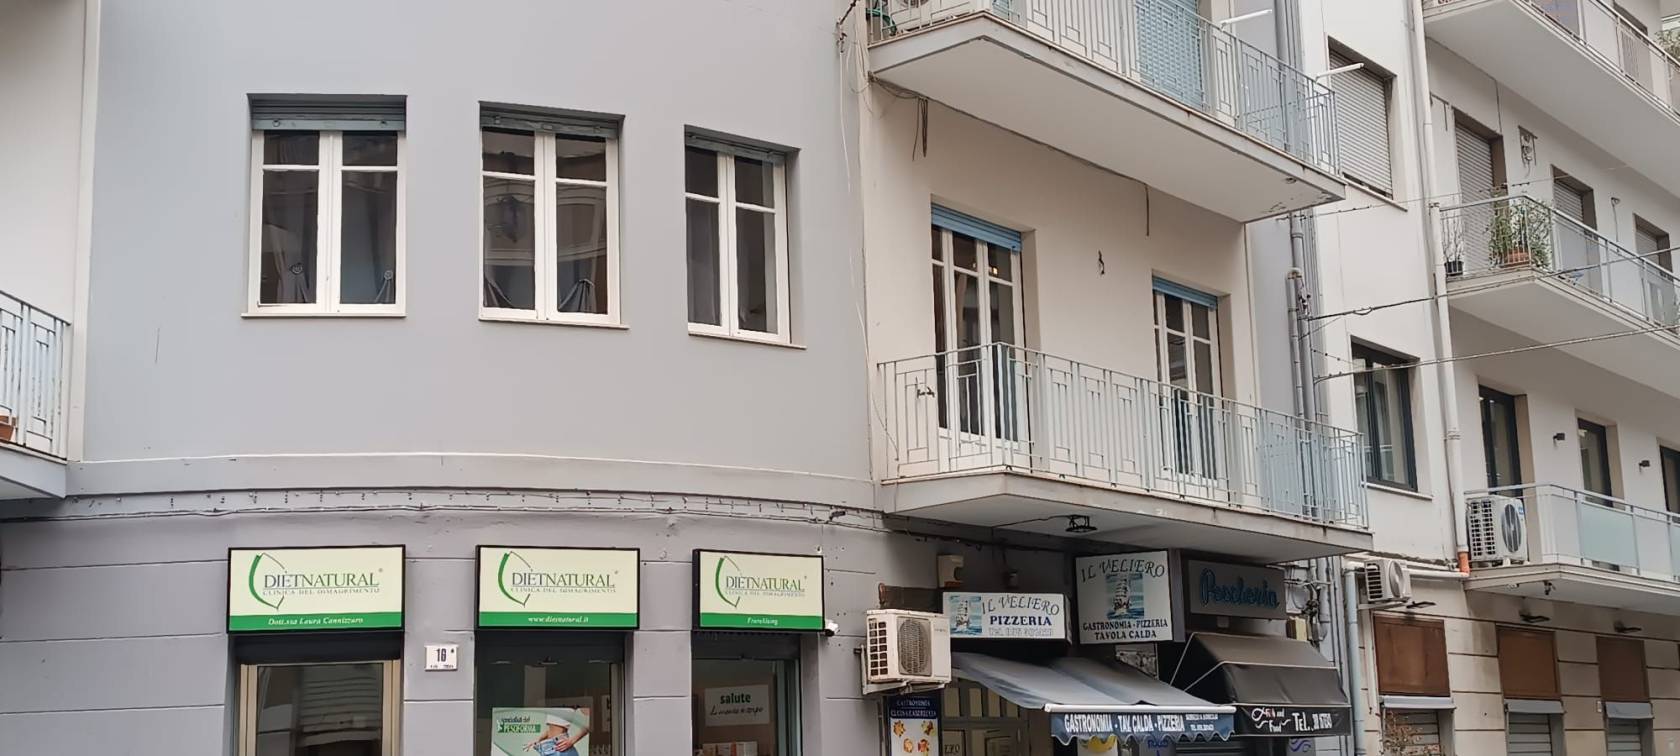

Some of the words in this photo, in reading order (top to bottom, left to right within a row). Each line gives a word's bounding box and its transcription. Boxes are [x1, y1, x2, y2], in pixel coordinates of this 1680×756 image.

[1081, 564, 1096, 582] IL
[1100, 559, 1165, 578] VELIERO
[299, 588, 315, 596] DEL
[982, 599, 996, 615] IL
[998, 594, 1060, 616] VELIERO
[990, 615, 1052, 626] PIZZERIA
[1082, 620, 1132, 632] GASTRONOMIA
[1136, 618, 1168, 629] PIZZERIA
[1094, 630, 1127, 641] TAVOLA
[1128, 629, 1157, 639] CALDA
[720, 692, 751, 705] salute
[1064, 713, 1114, 733] GASTRONOMIA
[1132, 714, 1155, 733] CALDA
[1157, 714, 1185, 732] PIZZERIA
